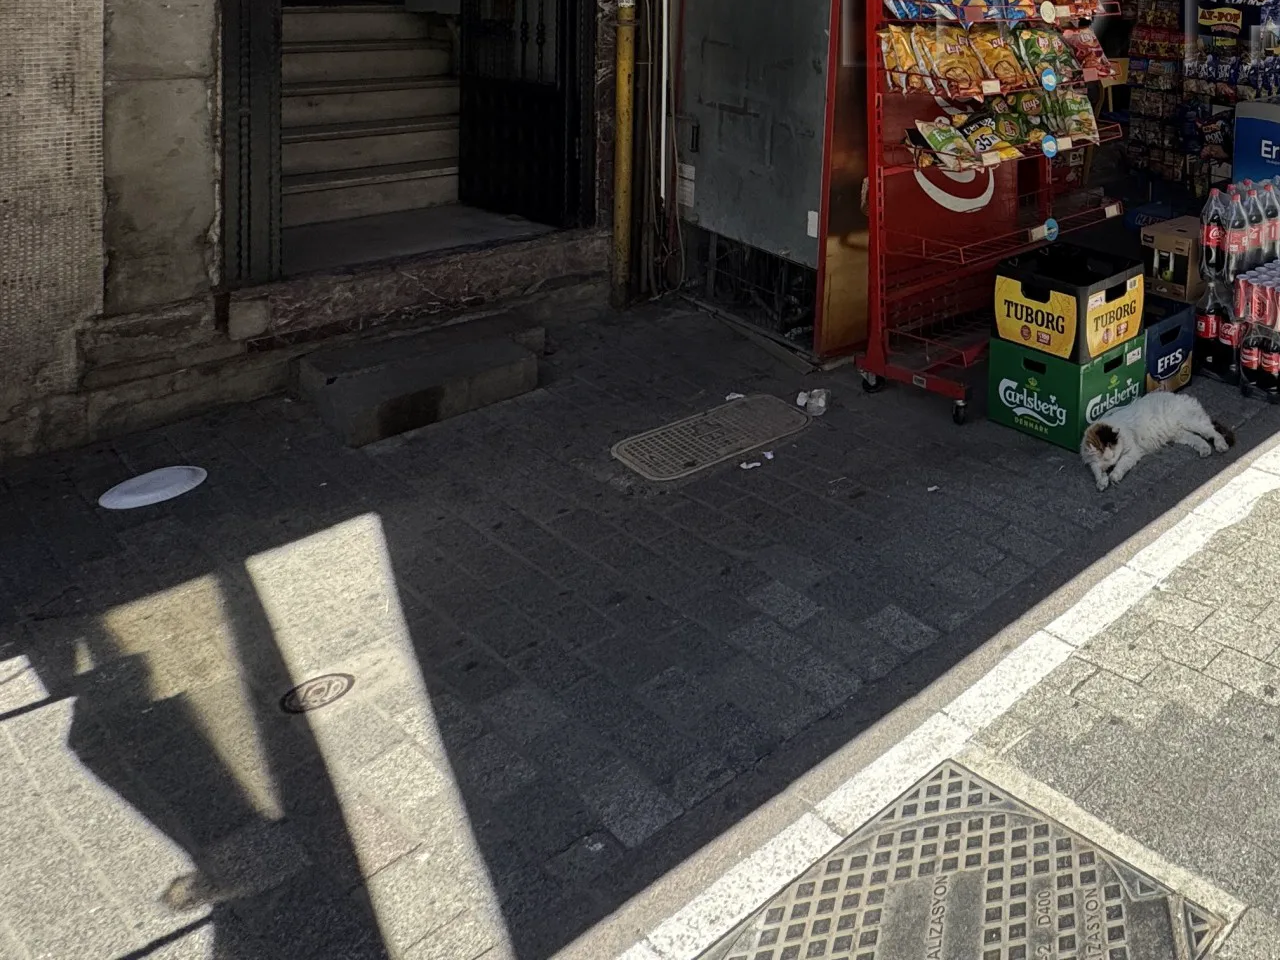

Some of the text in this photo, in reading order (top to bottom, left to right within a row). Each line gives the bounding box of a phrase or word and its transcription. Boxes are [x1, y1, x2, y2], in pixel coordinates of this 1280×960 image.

[1003, 299, 1065, 335] TUBORG
[1093, 299, 1137, 331] TUBORG
[1157, 348, 1183, 374] EFES
[998, 378, 1067, 427] Carlsberg
[1085, 377, 1140, 424] Carlsberg
[1014, 415, 1049, 435] DENMARK
[926, 874, 949, 960] ALİZASYON
[1037, 890, 1050, 927] D400
